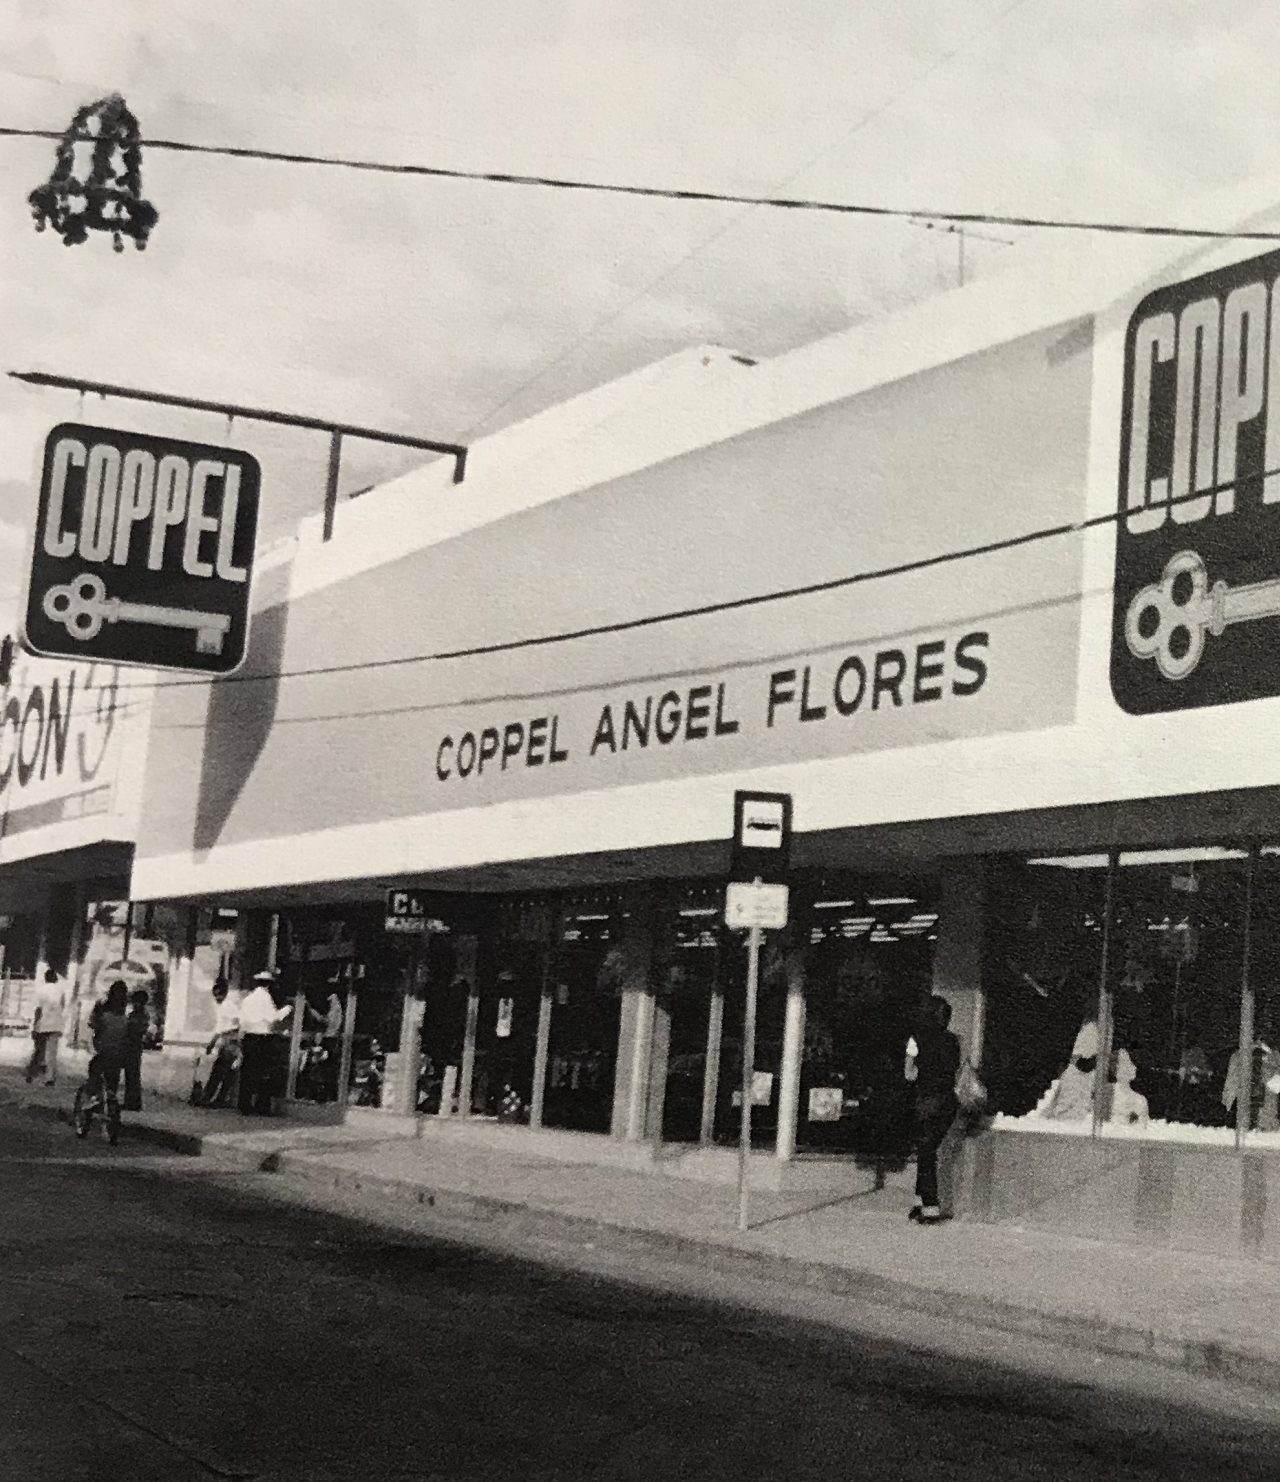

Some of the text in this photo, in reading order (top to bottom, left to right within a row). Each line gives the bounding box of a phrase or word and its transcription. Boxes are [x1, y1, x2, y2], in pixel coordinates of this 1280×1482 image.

[43, 438, 247, 583] COPPEL
[436, 631, 990, 781] COPPEL ANGEL FLORES
